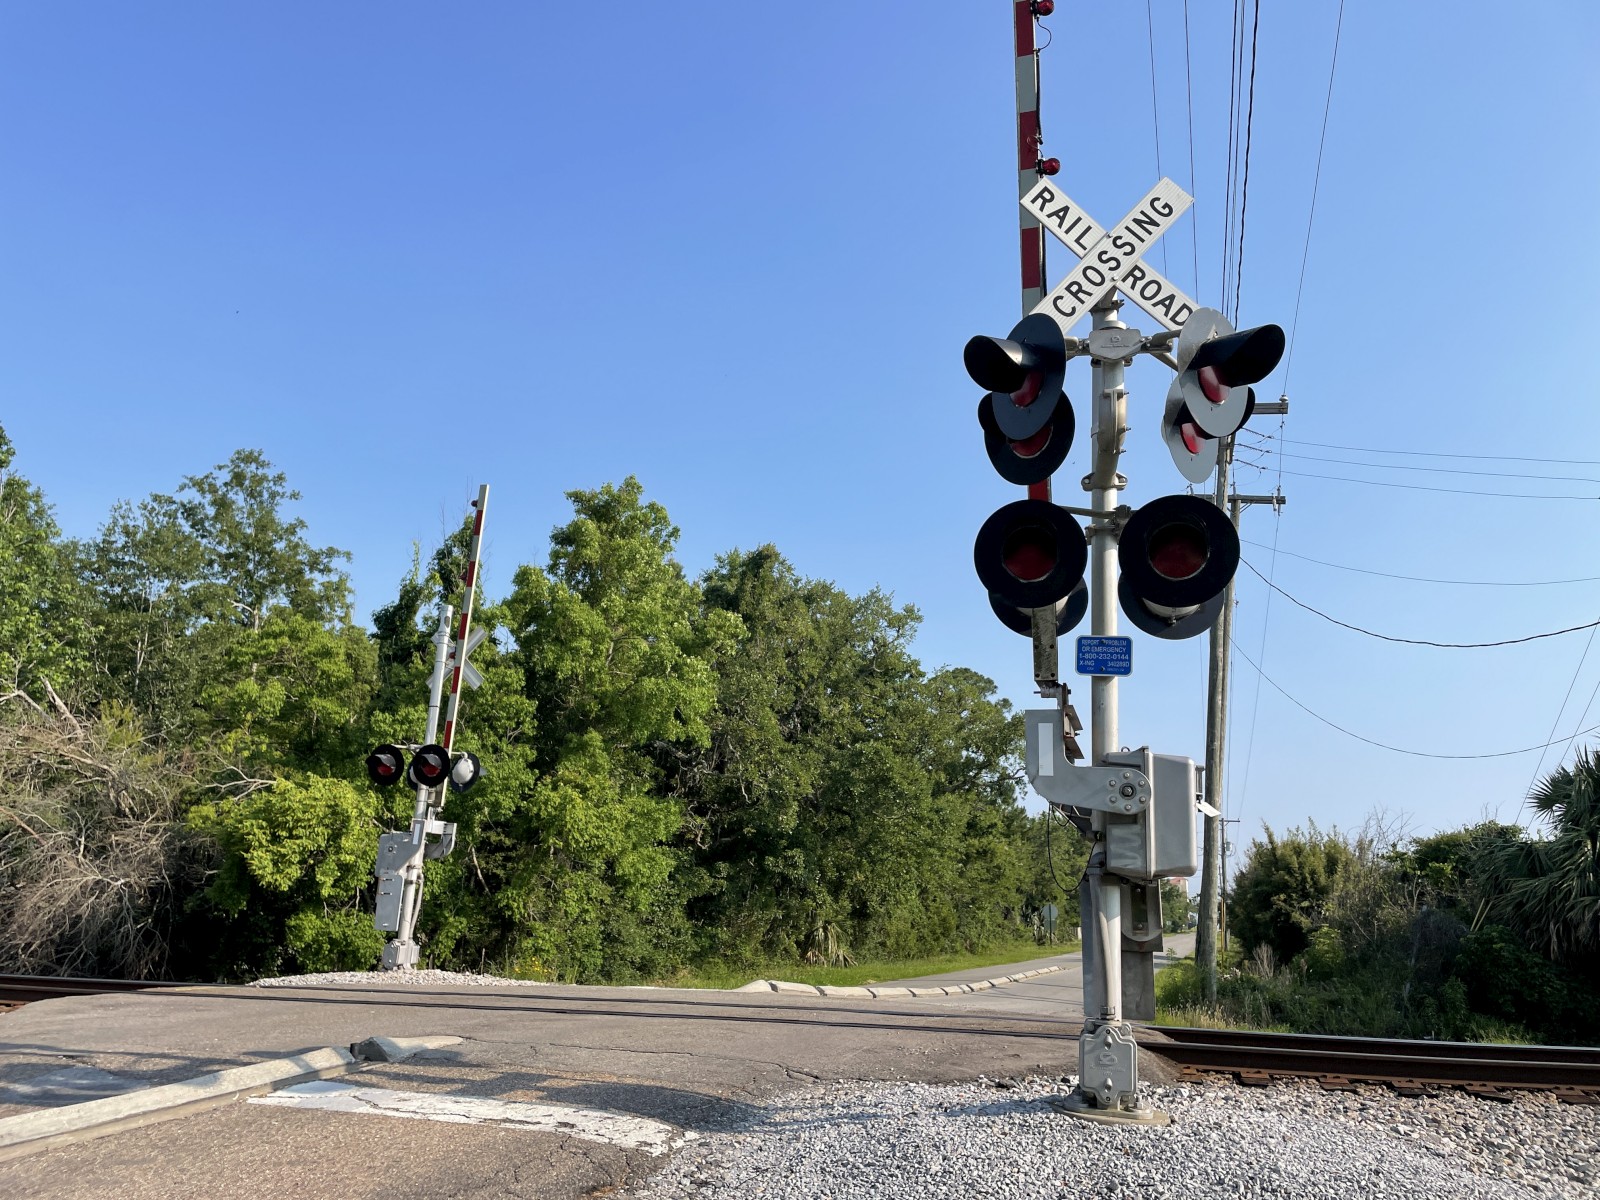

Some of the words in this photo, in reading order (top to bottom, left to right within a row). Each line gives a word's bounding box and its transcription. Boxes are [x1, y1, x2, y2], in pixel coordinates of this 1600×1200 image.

[1030, 186, 1092, 250] RAIL
[1052, 197, 1174, 318] CROSSING
[1121, 264, 1193, 326] ROAD
